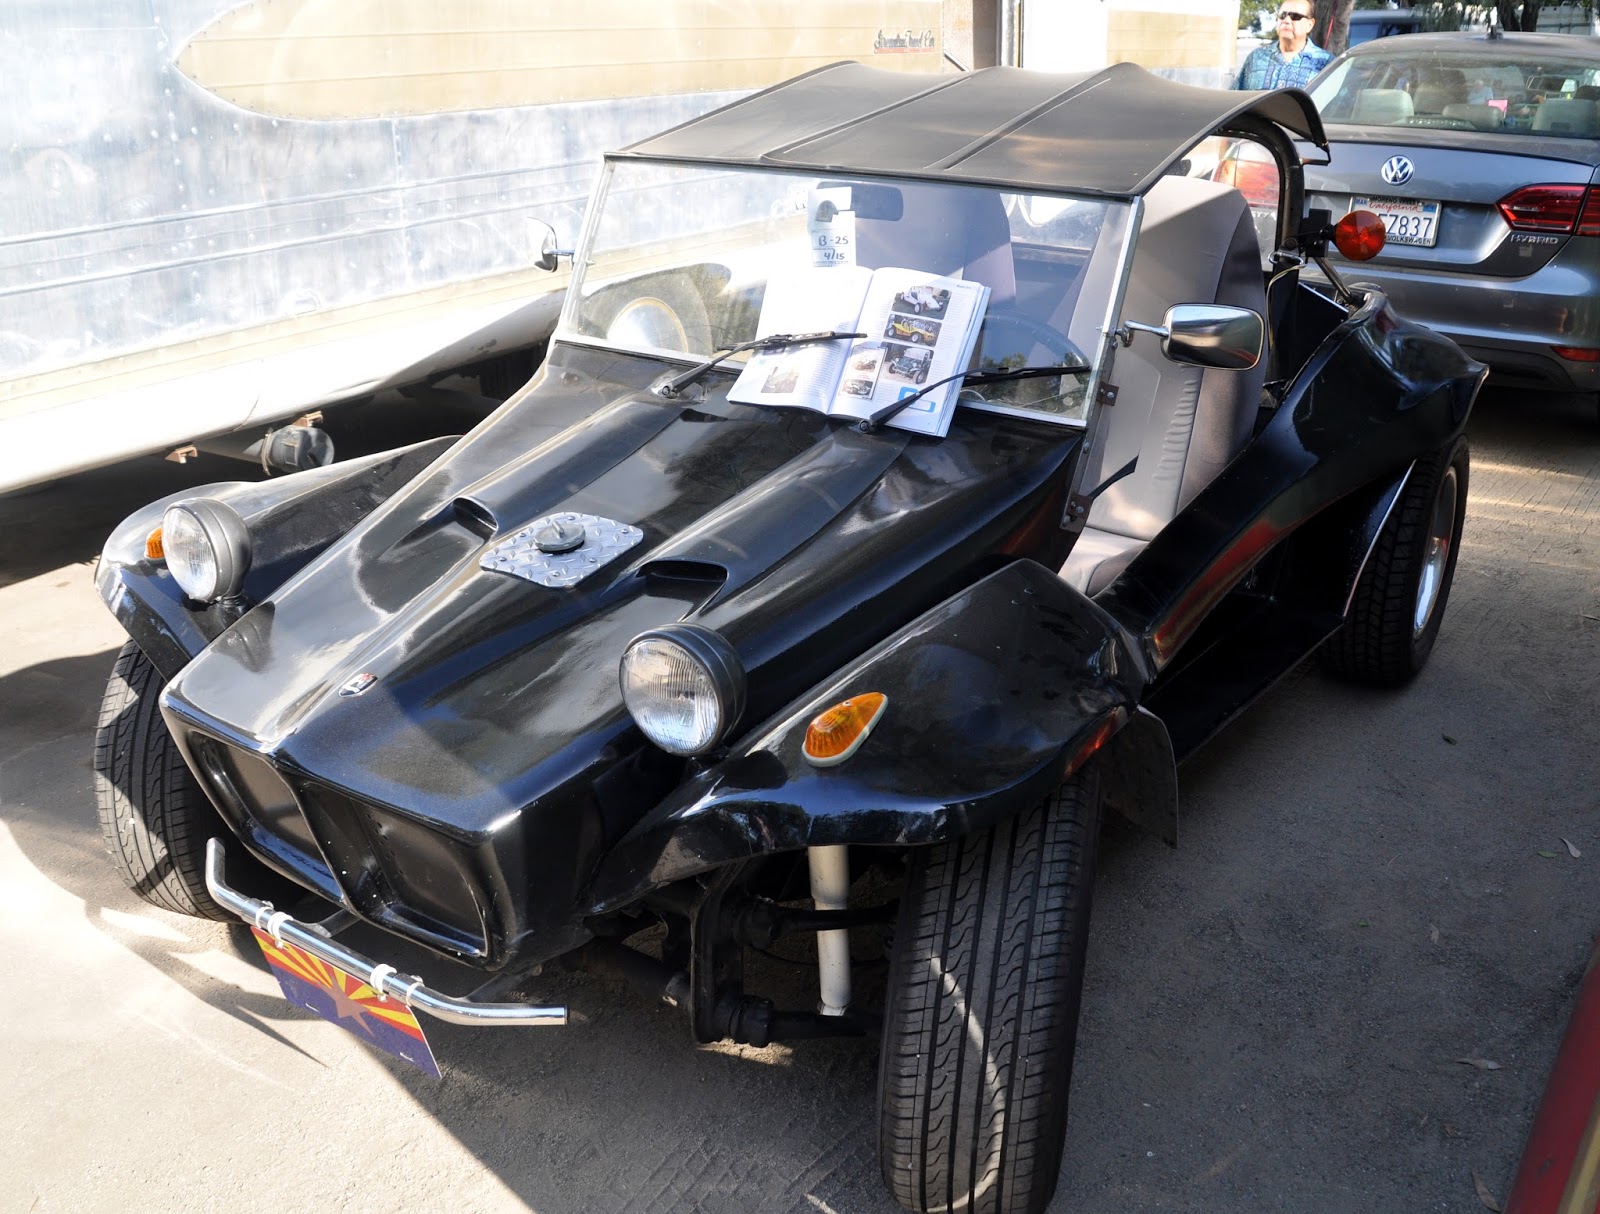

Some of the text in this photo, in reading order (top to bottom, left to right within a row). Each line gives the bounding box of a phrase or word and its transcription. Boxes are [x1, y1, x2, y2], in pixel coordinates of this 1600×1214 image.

[1381, 155, 1414, 186] VW
[1369, 201, 1422, 213] California
[1386, 235, 1432, 245] VOLKSWAGEN
[1510, 234, 1559, 245] HYBRID
[824, 248, 846, 261] 4/15
